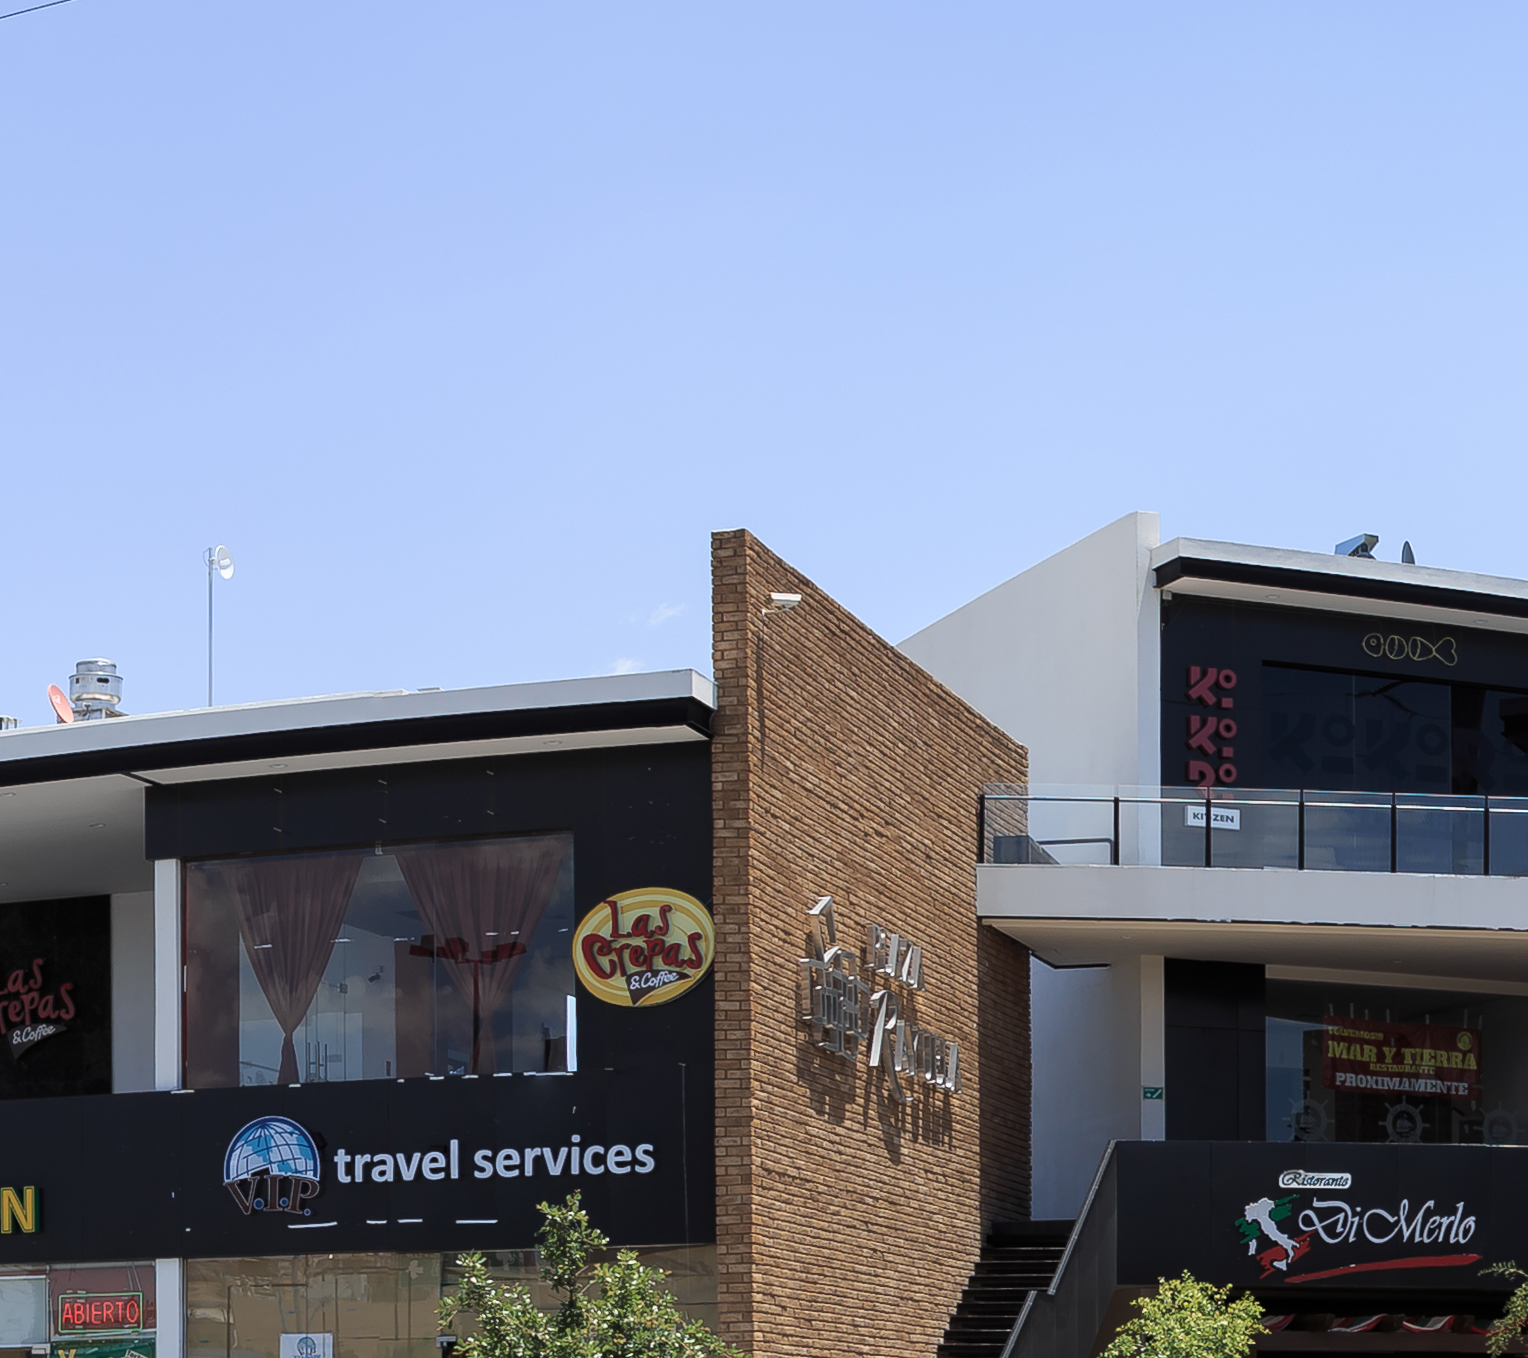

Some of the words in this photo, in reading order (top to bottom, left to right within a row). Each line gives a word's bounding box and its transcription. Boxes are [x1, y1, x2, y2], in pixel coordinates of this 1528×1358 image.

[1192, 811, 1235, 824] KIZEN
[603, 899, 673, 939] Las
[581, 931, 703, 980] Crepas
[1328, 1040, 1377, 1062] MAR
[1382, 1047, 1397, 1064] Y
[1401, 1048, 1477, 1070] TIERRA
[1369, 1062, 1436, 1075] RESTAURANTE
[1335, 1072, 1469, 1096] PROXIMAMENTE
[334, 1139, 460, 1184] travel
[473, 1134, 656, 1179] services
[1281, 1171, 1350, 1188] Ristorante
[1299, 1198, 1362, 1244] Di
[1362, 1199, 1477, 1244] Merlo
[61, 1300, 140, 1324] ABIERTO
